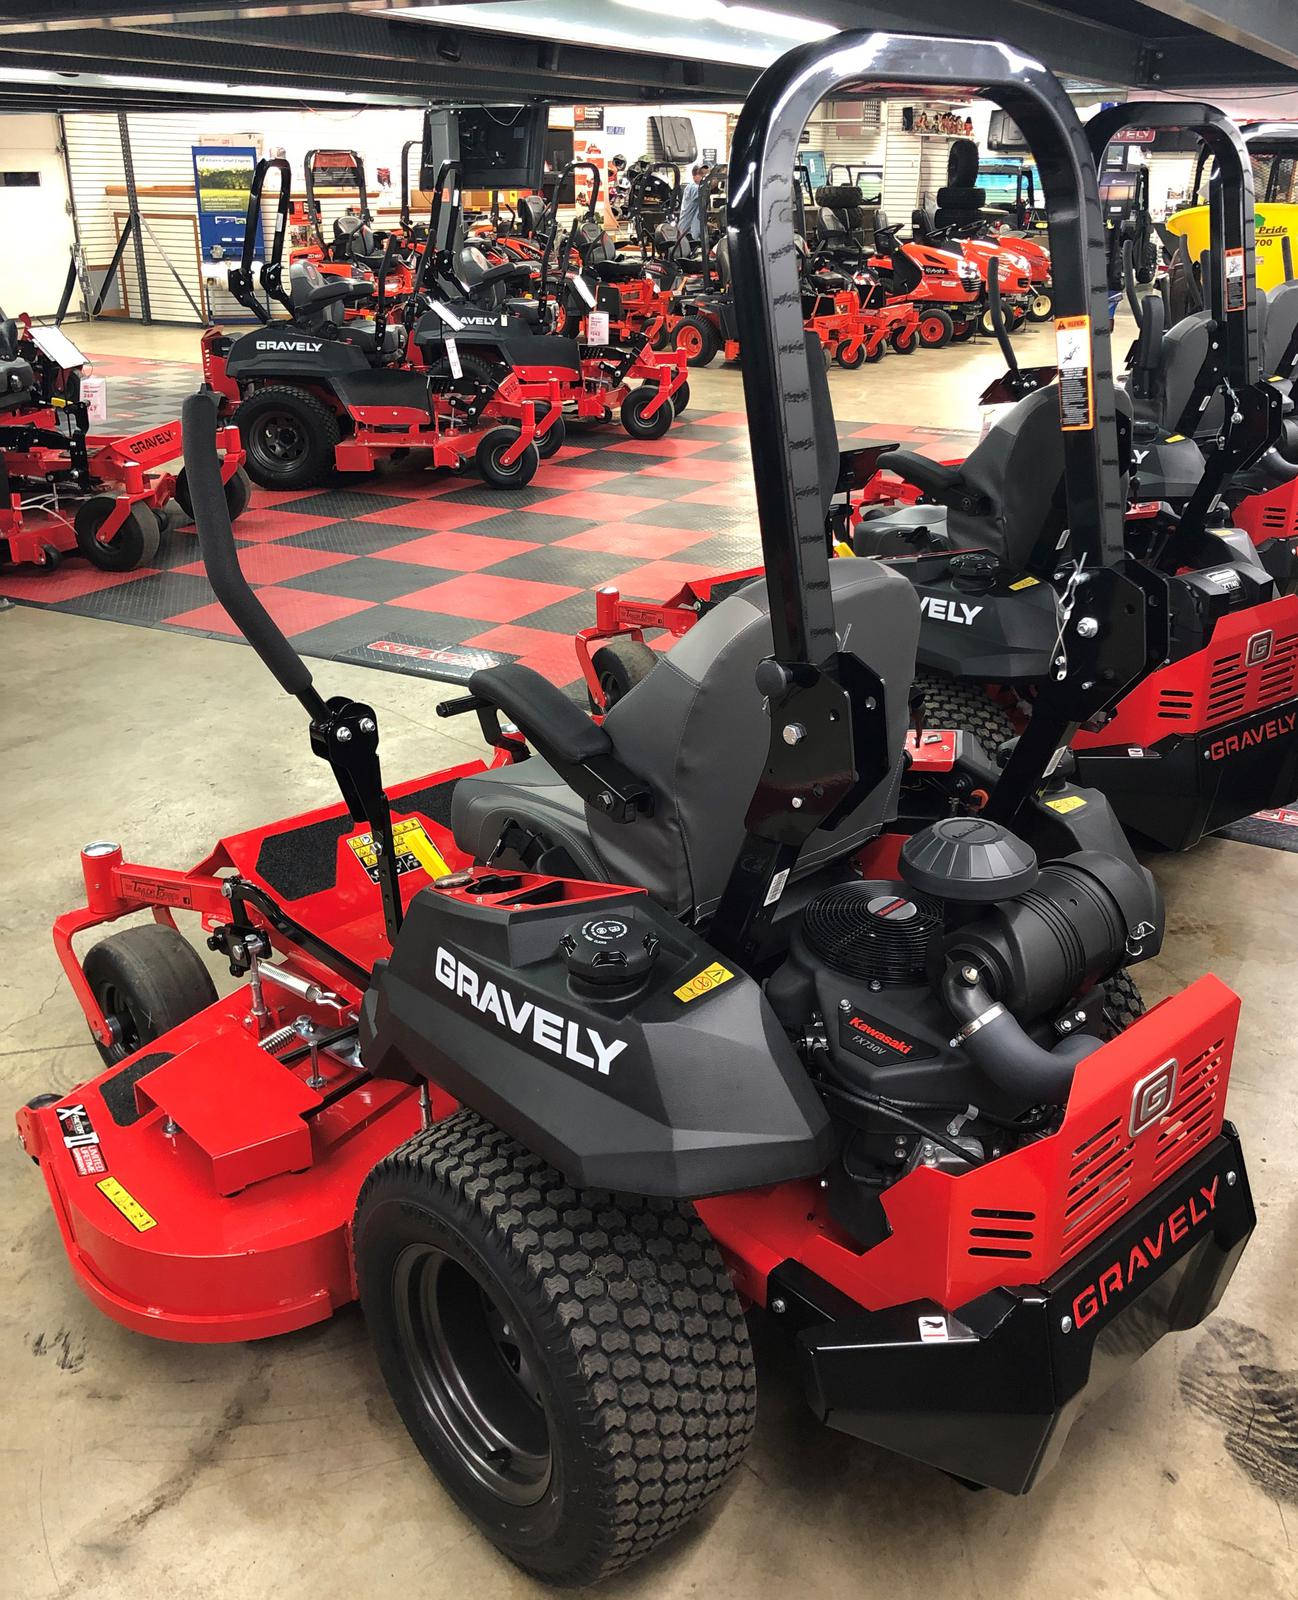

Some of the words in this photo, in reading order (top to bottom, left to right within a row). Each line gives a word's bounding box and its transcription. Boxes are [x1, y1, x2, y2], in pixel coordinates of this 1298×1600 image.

[1258, 226, 1288, 236] Pride
[256, 340, 323, 352] GRAVELY
[129, 430, 174, 454] GRAVELY
[920, 596, 984, 625] VELY
[1211, 712, 1296, 760] GRAVELY
[434, 945, 629, 1076] GRAVELY
[848, 1016, 913, 1055] Kawasaki
[852, 1035, 887, 1055] FX730V
[80, 1146, 96, 1174] LIFETIME
[88, 1145, 105, 1172] LIMITED
[1071, 1174, 1218, 1330] GRAVELY
